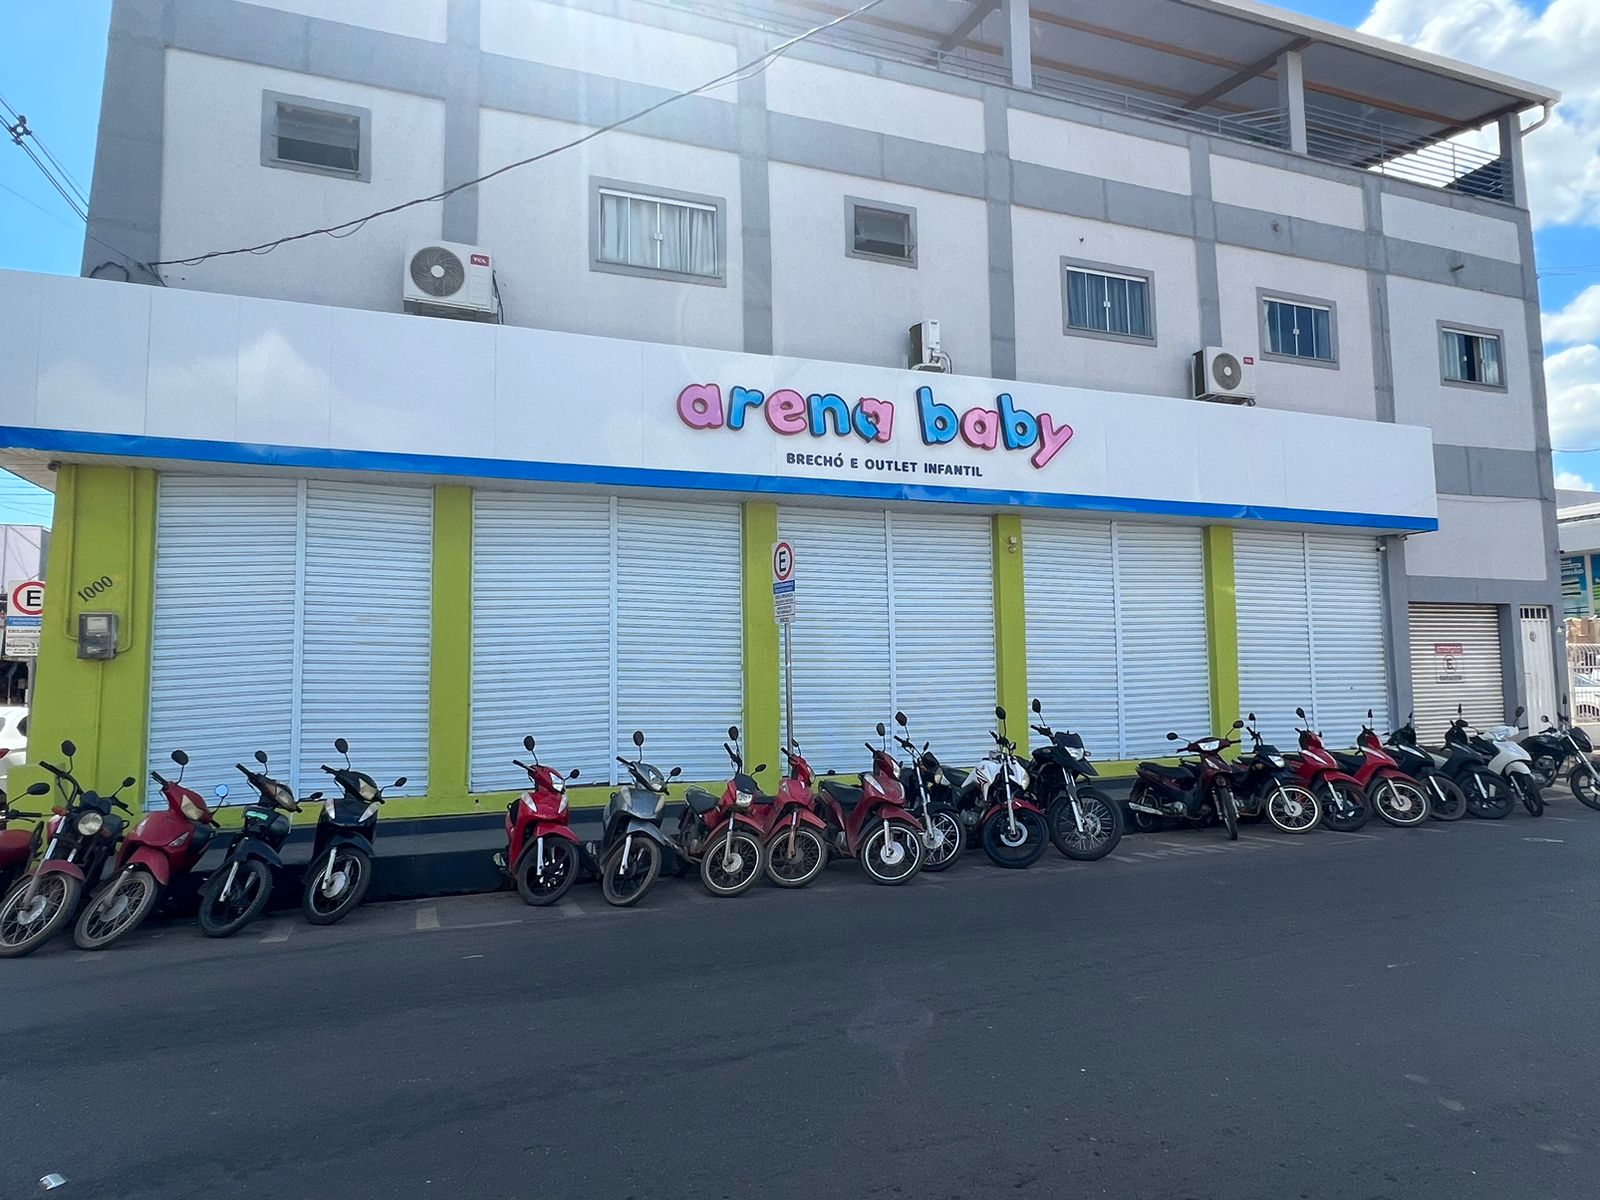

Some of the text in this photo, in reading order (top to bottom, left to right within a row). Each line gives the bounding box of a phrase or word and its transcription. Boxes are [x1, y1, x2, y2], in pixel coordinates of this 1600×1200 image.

[677, 383, 1074, 469] arena baby
[786, 452, 983, 477] BRECHÓ E OUTLET INFANTIL
[779, 550, 786, 572] E
[26, 589, 42, 607] E
[77, 575, 114, 603] 1000
